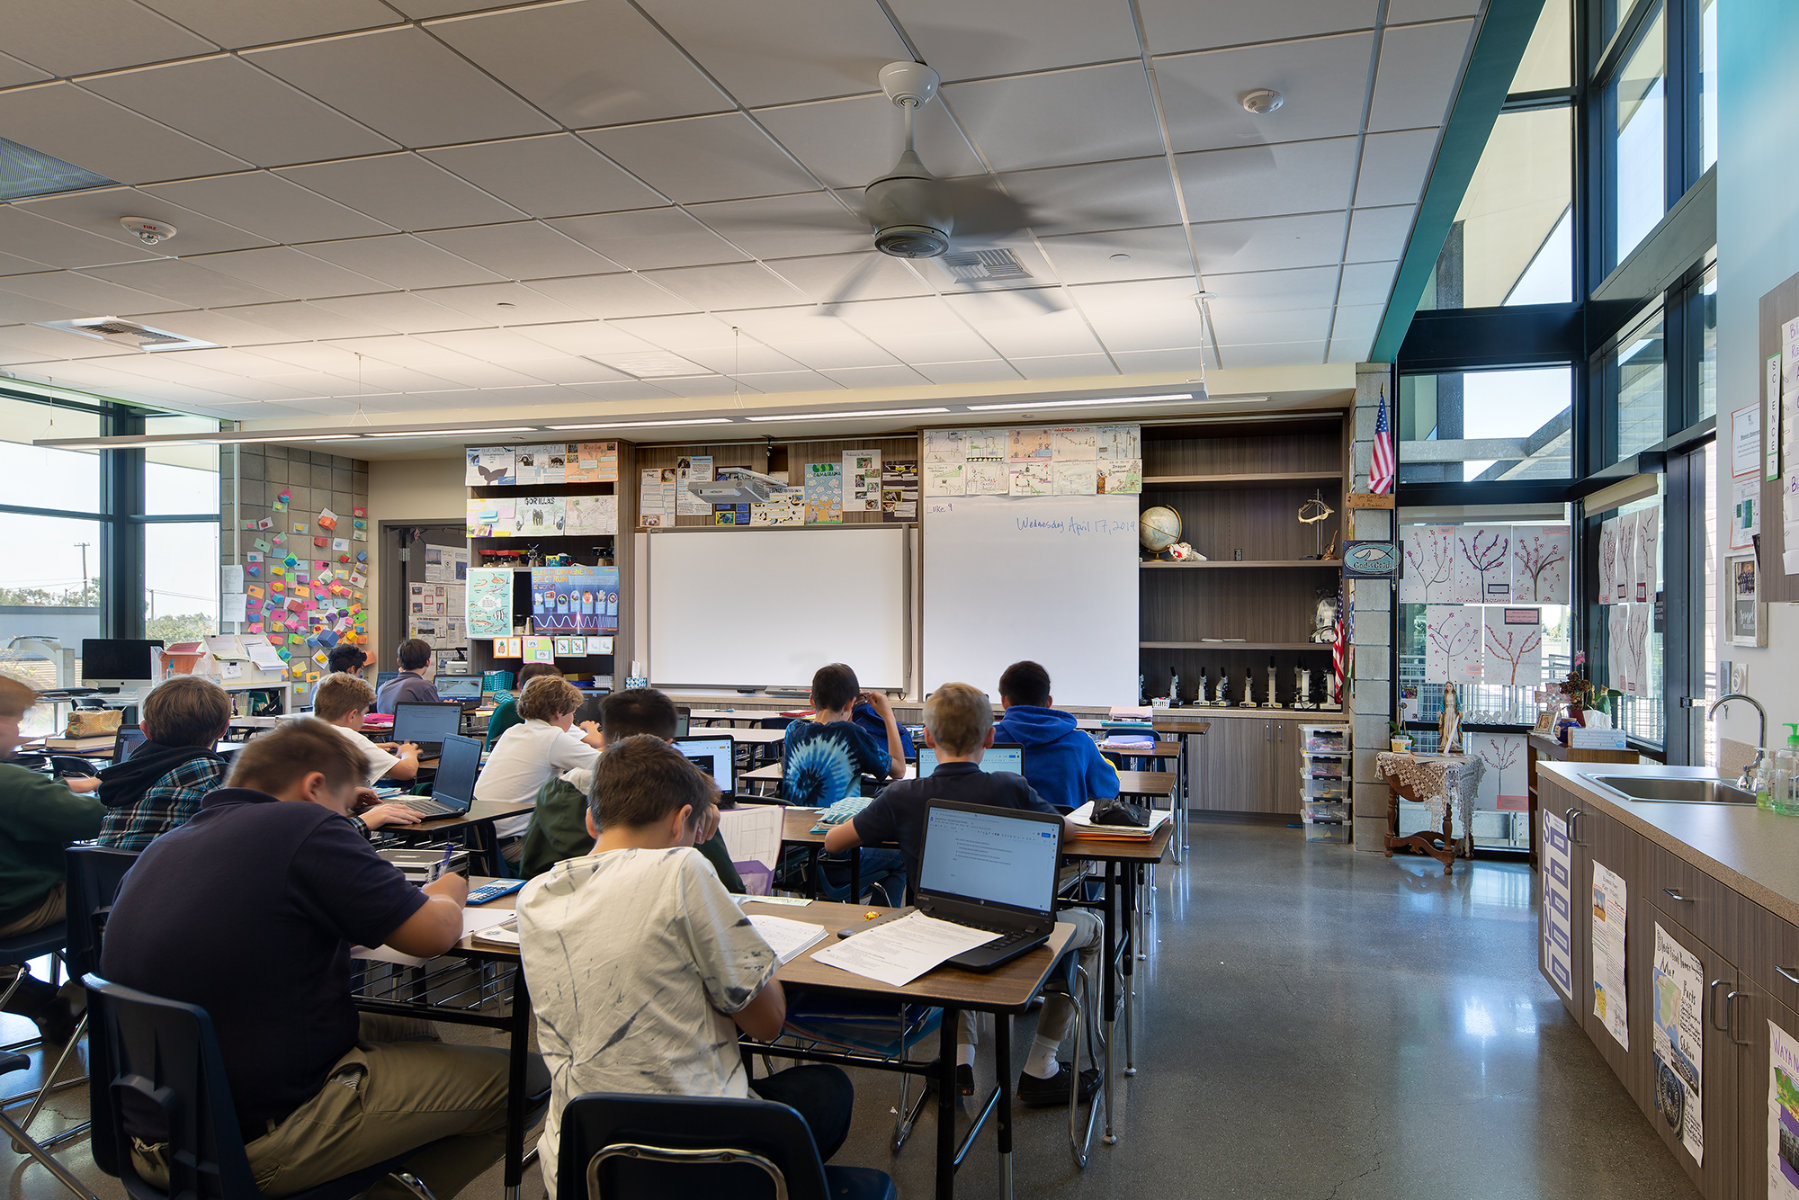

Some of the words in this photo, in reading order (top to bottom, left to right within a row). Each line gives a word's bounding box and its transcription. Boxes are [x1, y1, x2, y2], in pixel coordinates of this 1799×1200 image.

[525, 497, 555, 506] GORILLAS
[1016, 517, 1065, 533] Wednesday
[1068, 516, 1090, 536] April
[1112, 521, 1136, 533] 2019
[1353, 561, 1368, 569] God
[532, 568, 595, 576] ELECTROMAGNETIC
[532, 576, 568, 584] SPECTRUM
[1544, 810, 1552, 969] SLANT
